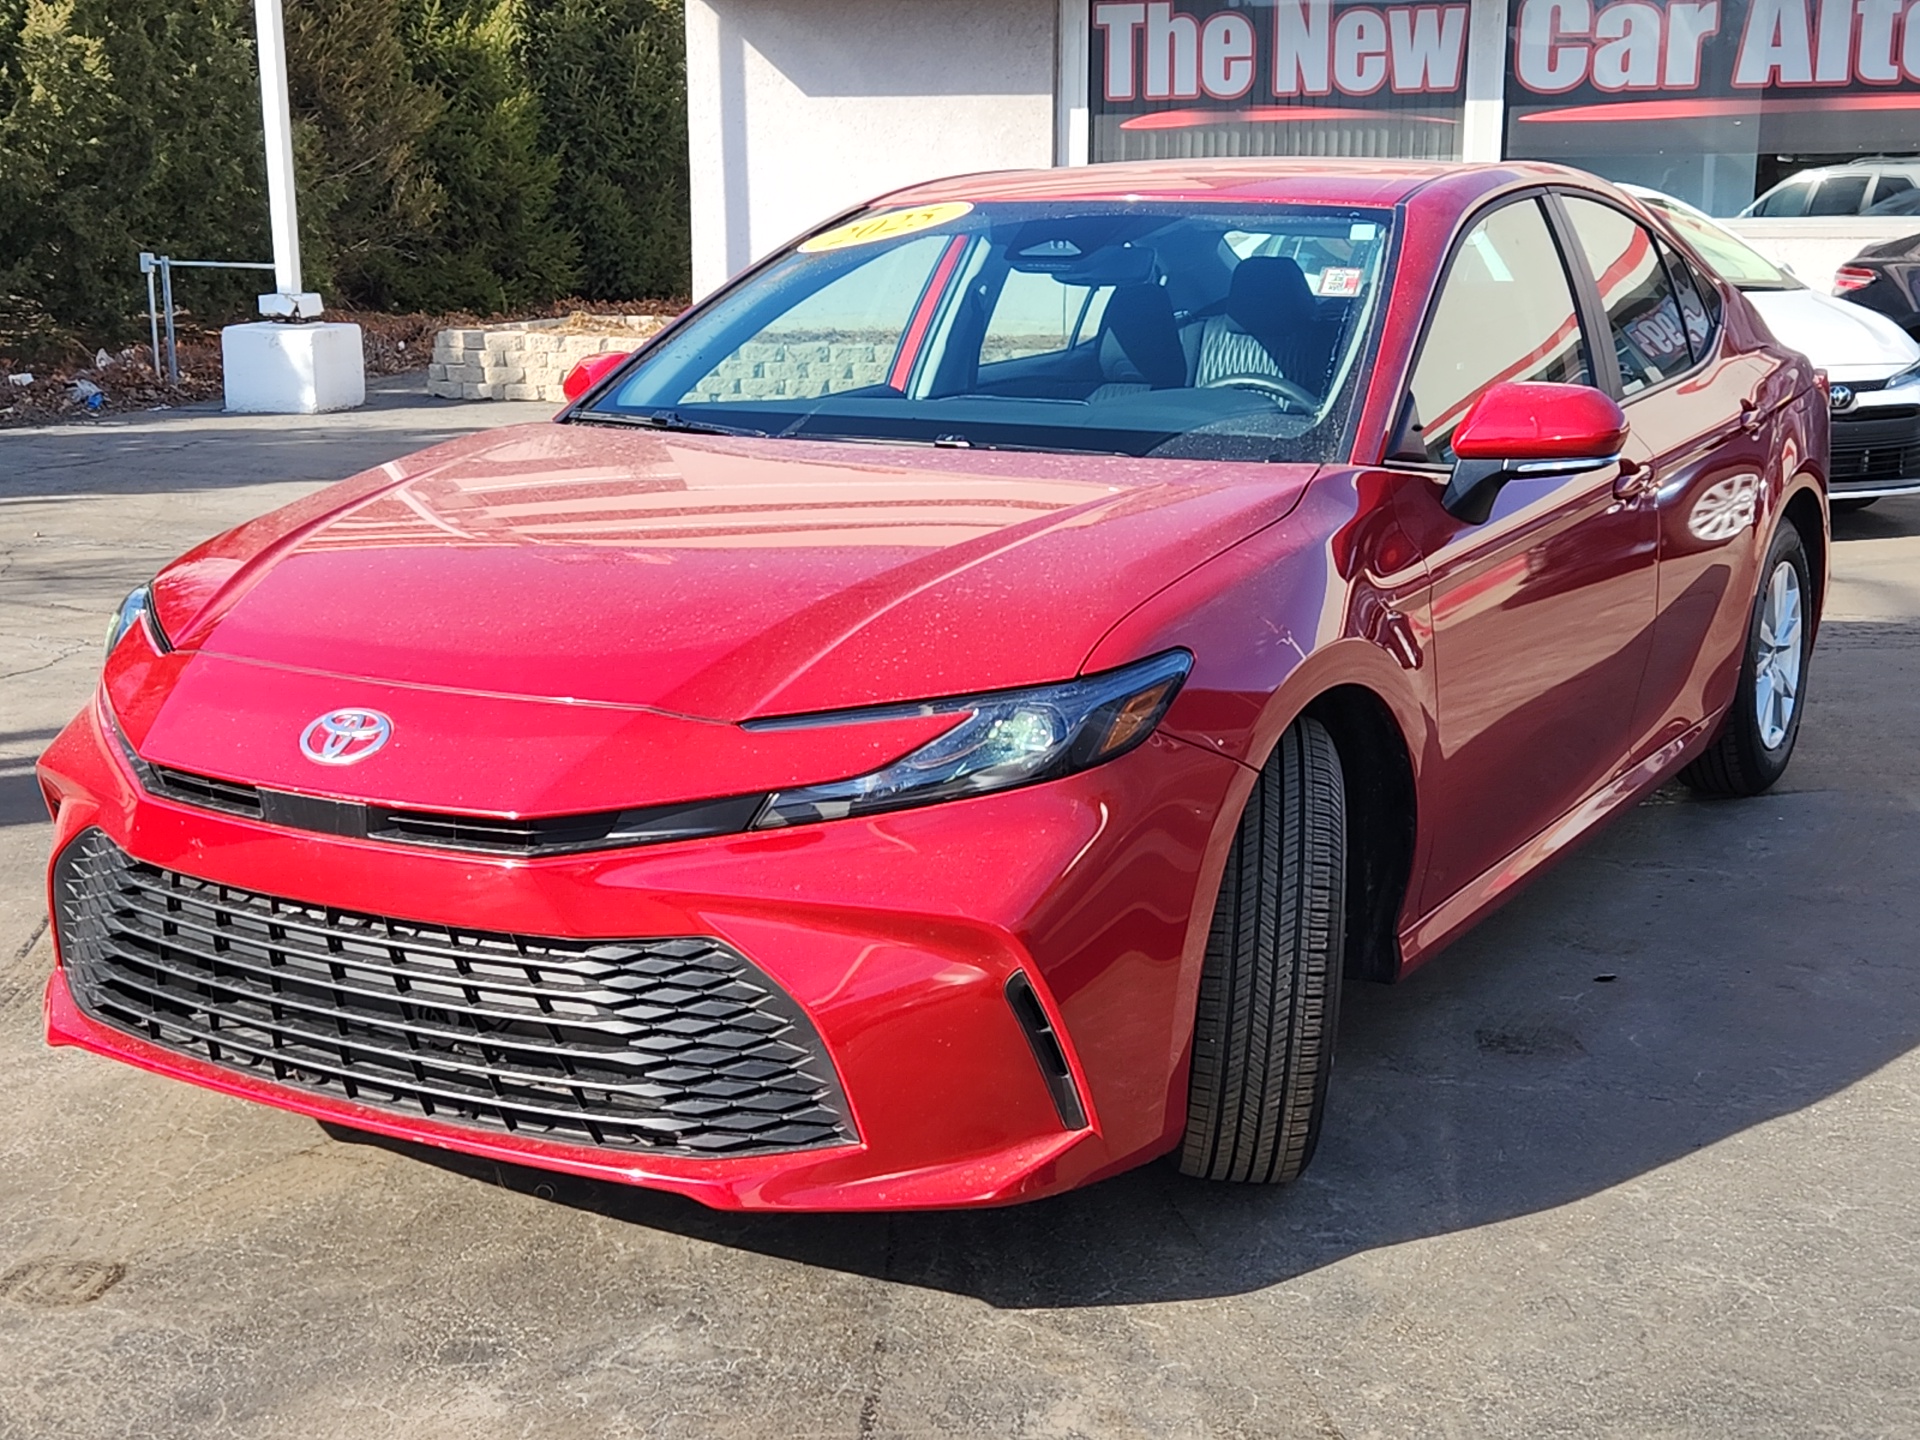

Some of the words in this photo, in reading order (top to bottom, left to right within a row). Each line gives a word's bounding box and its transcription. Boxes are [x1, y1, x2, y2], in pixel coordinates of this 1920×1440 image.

[1094, 1, 1256, 101] The
[1271, 0, 1470, 96] New
[1515, 0, 1721, 94] Car
